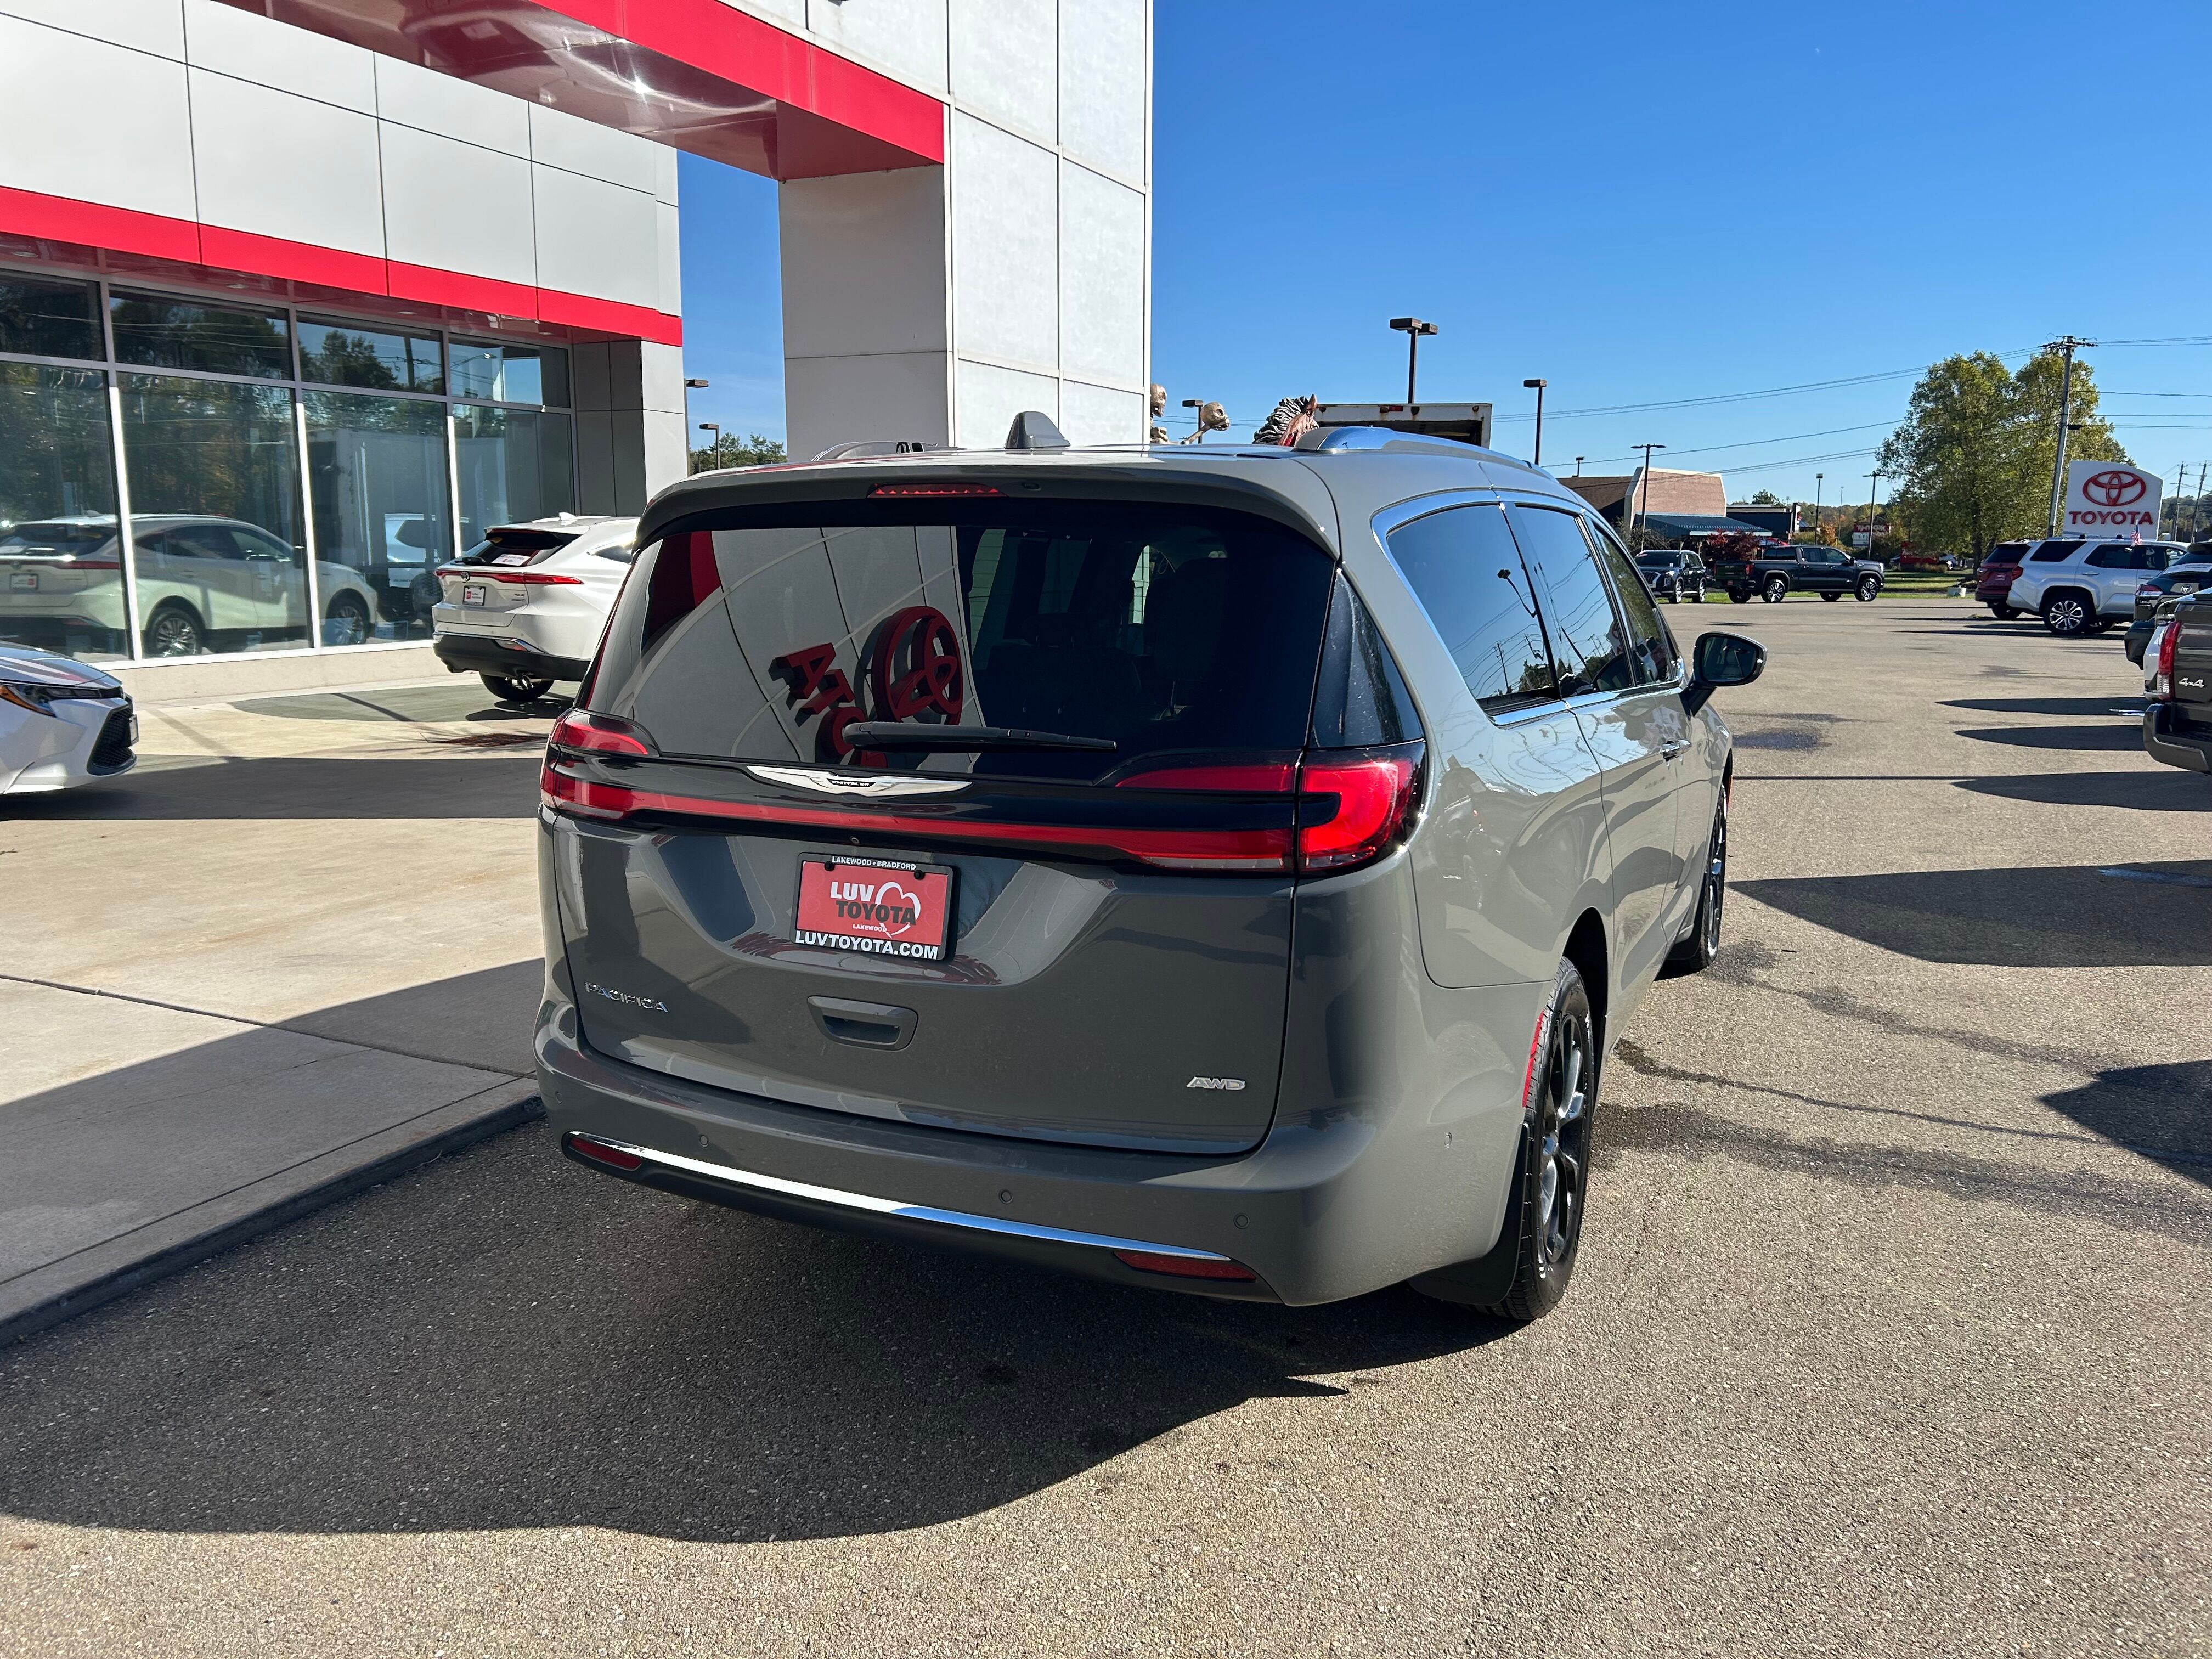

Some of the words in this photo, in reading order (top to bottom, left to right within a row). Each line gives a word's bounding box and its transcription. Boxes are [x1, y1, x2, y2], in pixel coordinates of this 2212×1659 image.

[2069, 511, 2153, 525] TOYOTA
[2179, 678, 2204, 688] 4x4
[832, 856, 872, 866] LAKEWOOD
[877, 861, 916, 870] BRADFORD
[830, 881, 874, 902] LUV
[836, 900, 916, 925] TOYOTA
[853, 923, 887, 933] LAKEWOOD
[795, 930, 939, 960] LUVTOYOTA.COM
[584, 981, 669, 1013] PACIFICA
[1186, 1076, 1245, 1090] AWD
